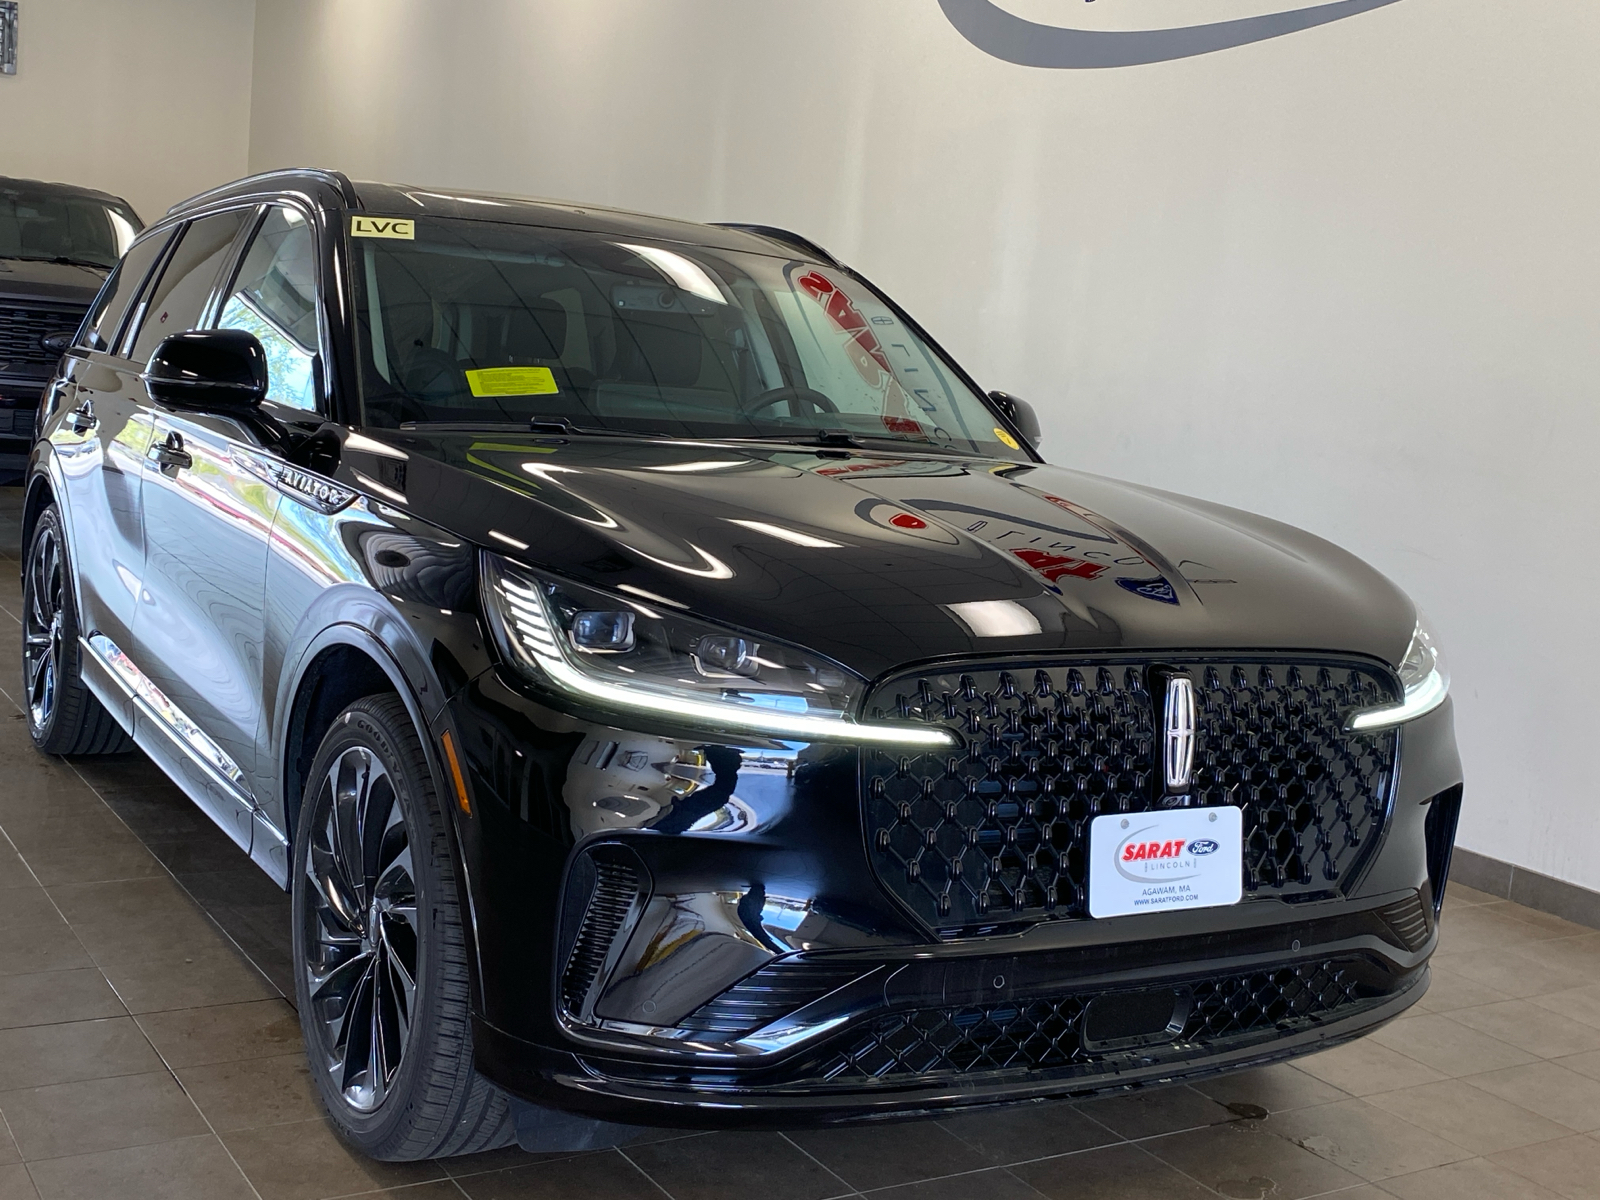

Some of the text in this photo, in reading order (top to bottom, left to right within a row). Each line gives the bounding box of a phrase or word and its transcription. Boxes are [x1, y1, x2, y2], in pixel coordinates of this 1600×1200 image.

[356, 220, 409, 235] LVC
[283, 469, 341, 504] AVIATOR
[1122, 840, 1215, 862] SARAT Ford
[1151, 860, 1191, 871] LINCOLN
[1142, 884, 1191, 897] AGAWAM, MA
